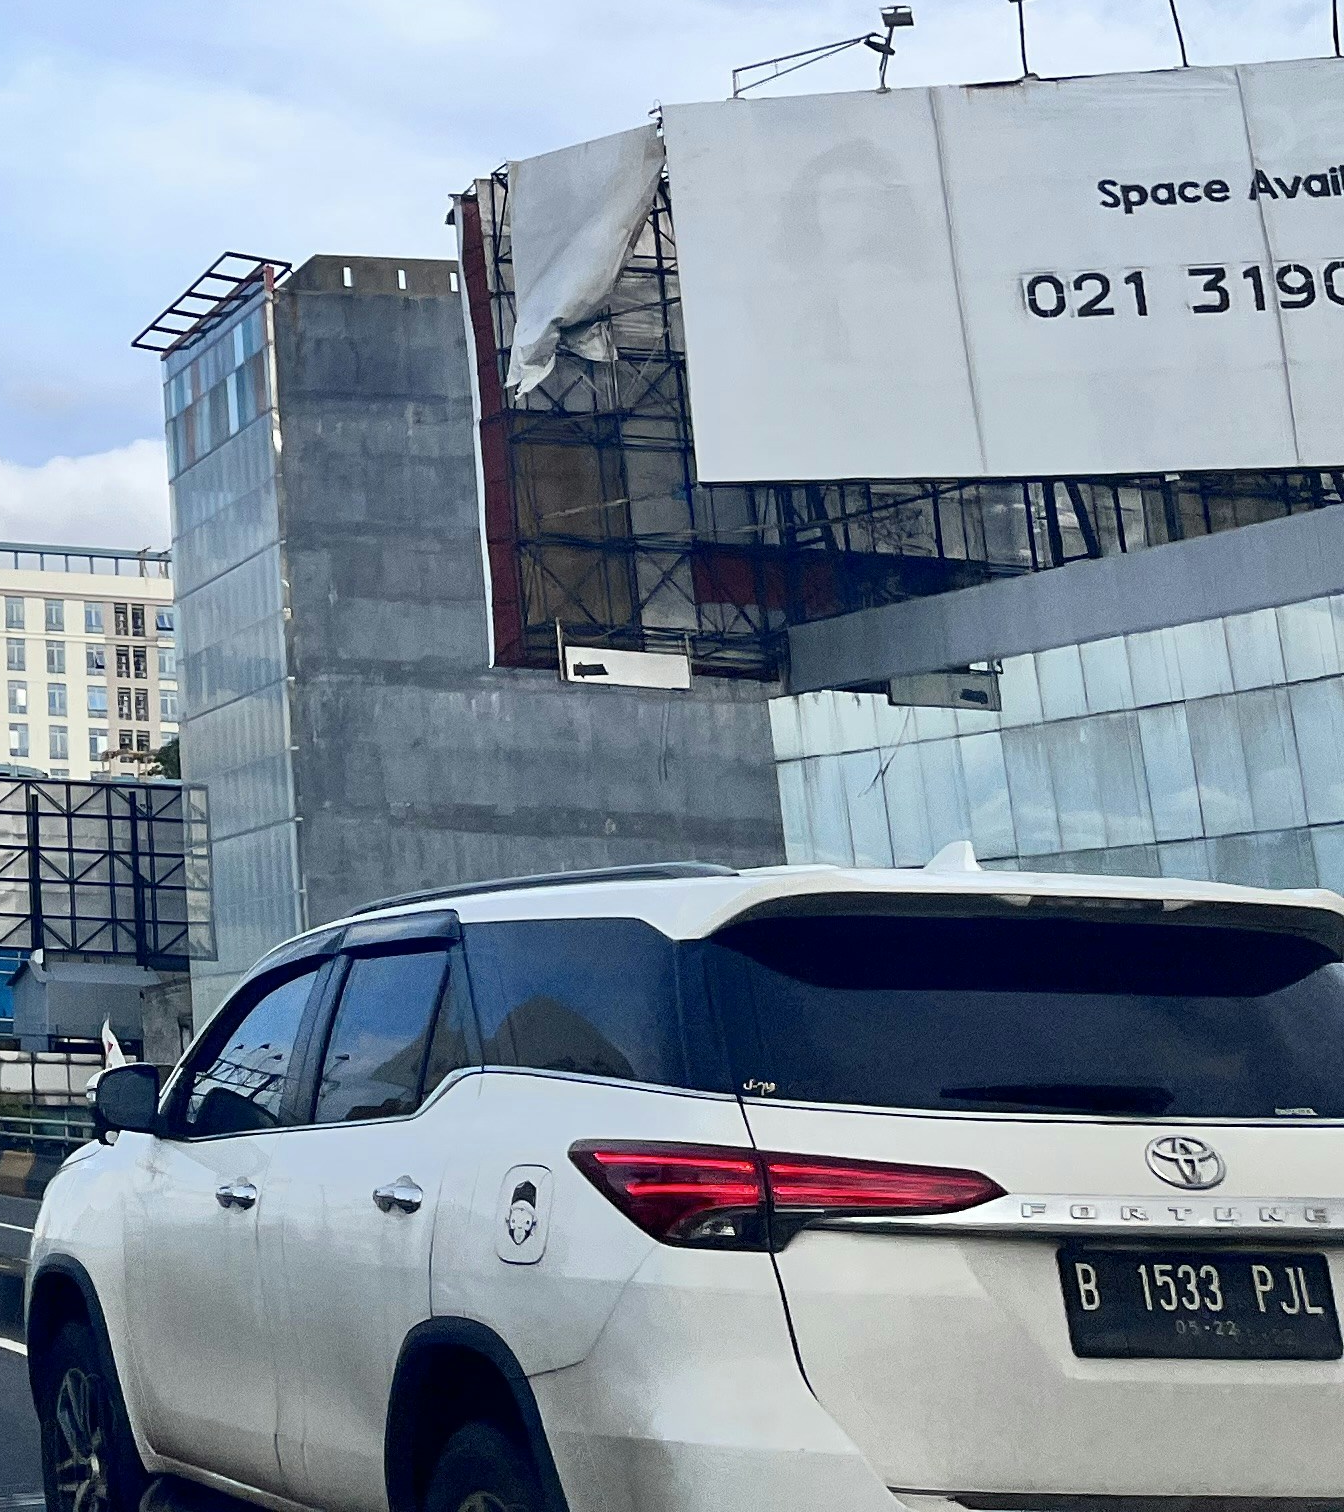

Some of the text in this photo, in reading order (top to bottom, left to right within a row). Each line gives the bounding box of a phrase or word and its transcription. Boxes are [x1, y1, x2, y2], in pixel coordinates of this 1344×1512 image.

[1097, 178, 1230, 215] Space
[1026, 269, 1148, 318] 021
[1021, 1202, 1329, 1224] FORTUNE
[1074, 1262, 1325, 1315] B 1533 PJL
